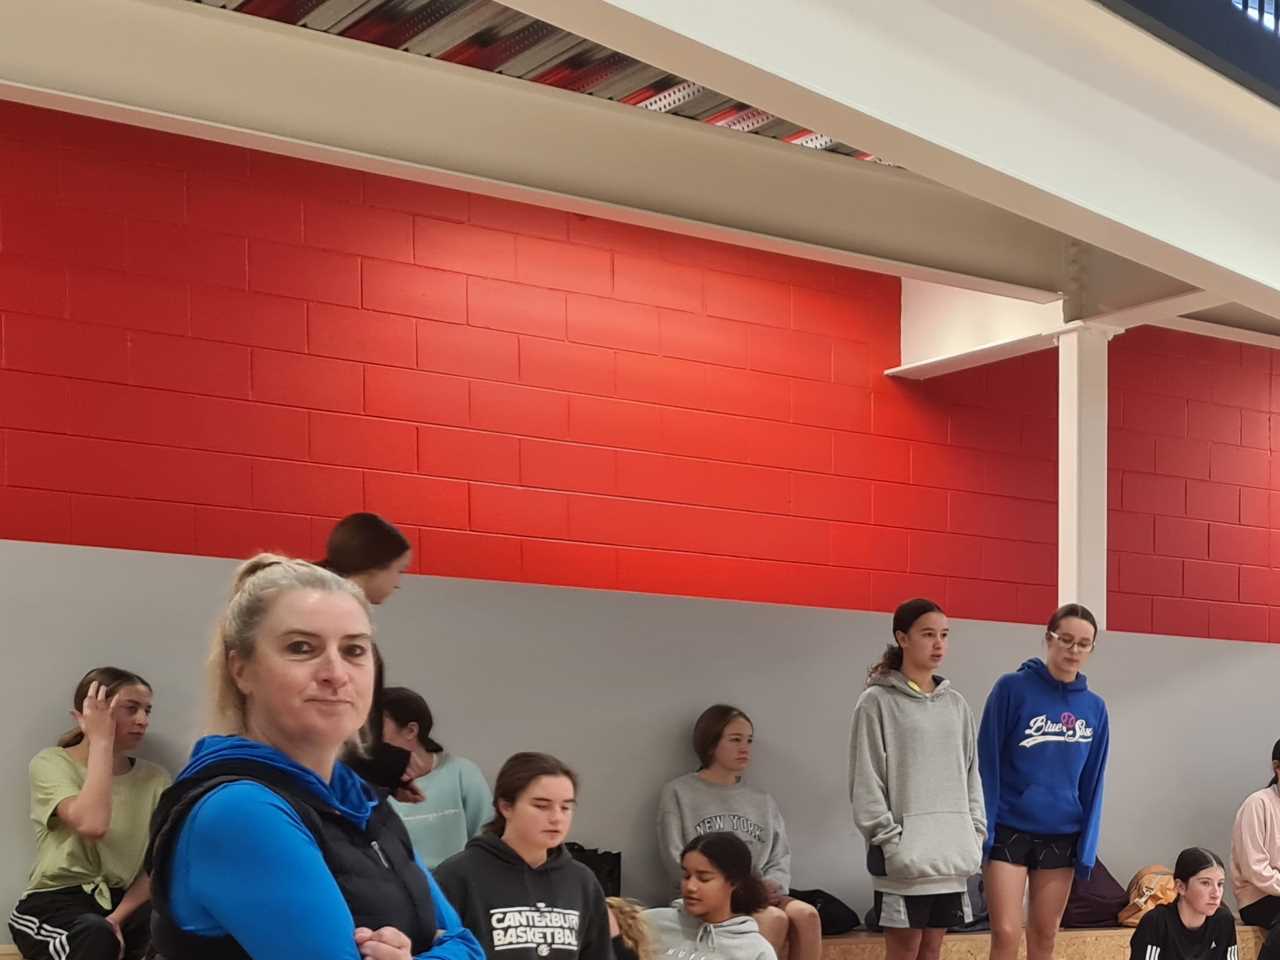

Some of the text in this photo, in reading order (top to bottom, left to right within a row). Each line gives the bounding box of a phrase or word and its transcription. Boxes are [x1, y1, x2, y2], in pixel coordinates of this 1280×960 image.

[1025, 714, 1066, 736] Blue
[695, 815, 765, 843] NEW YORK
[491, 911, 579, 929] CANTERBUR
